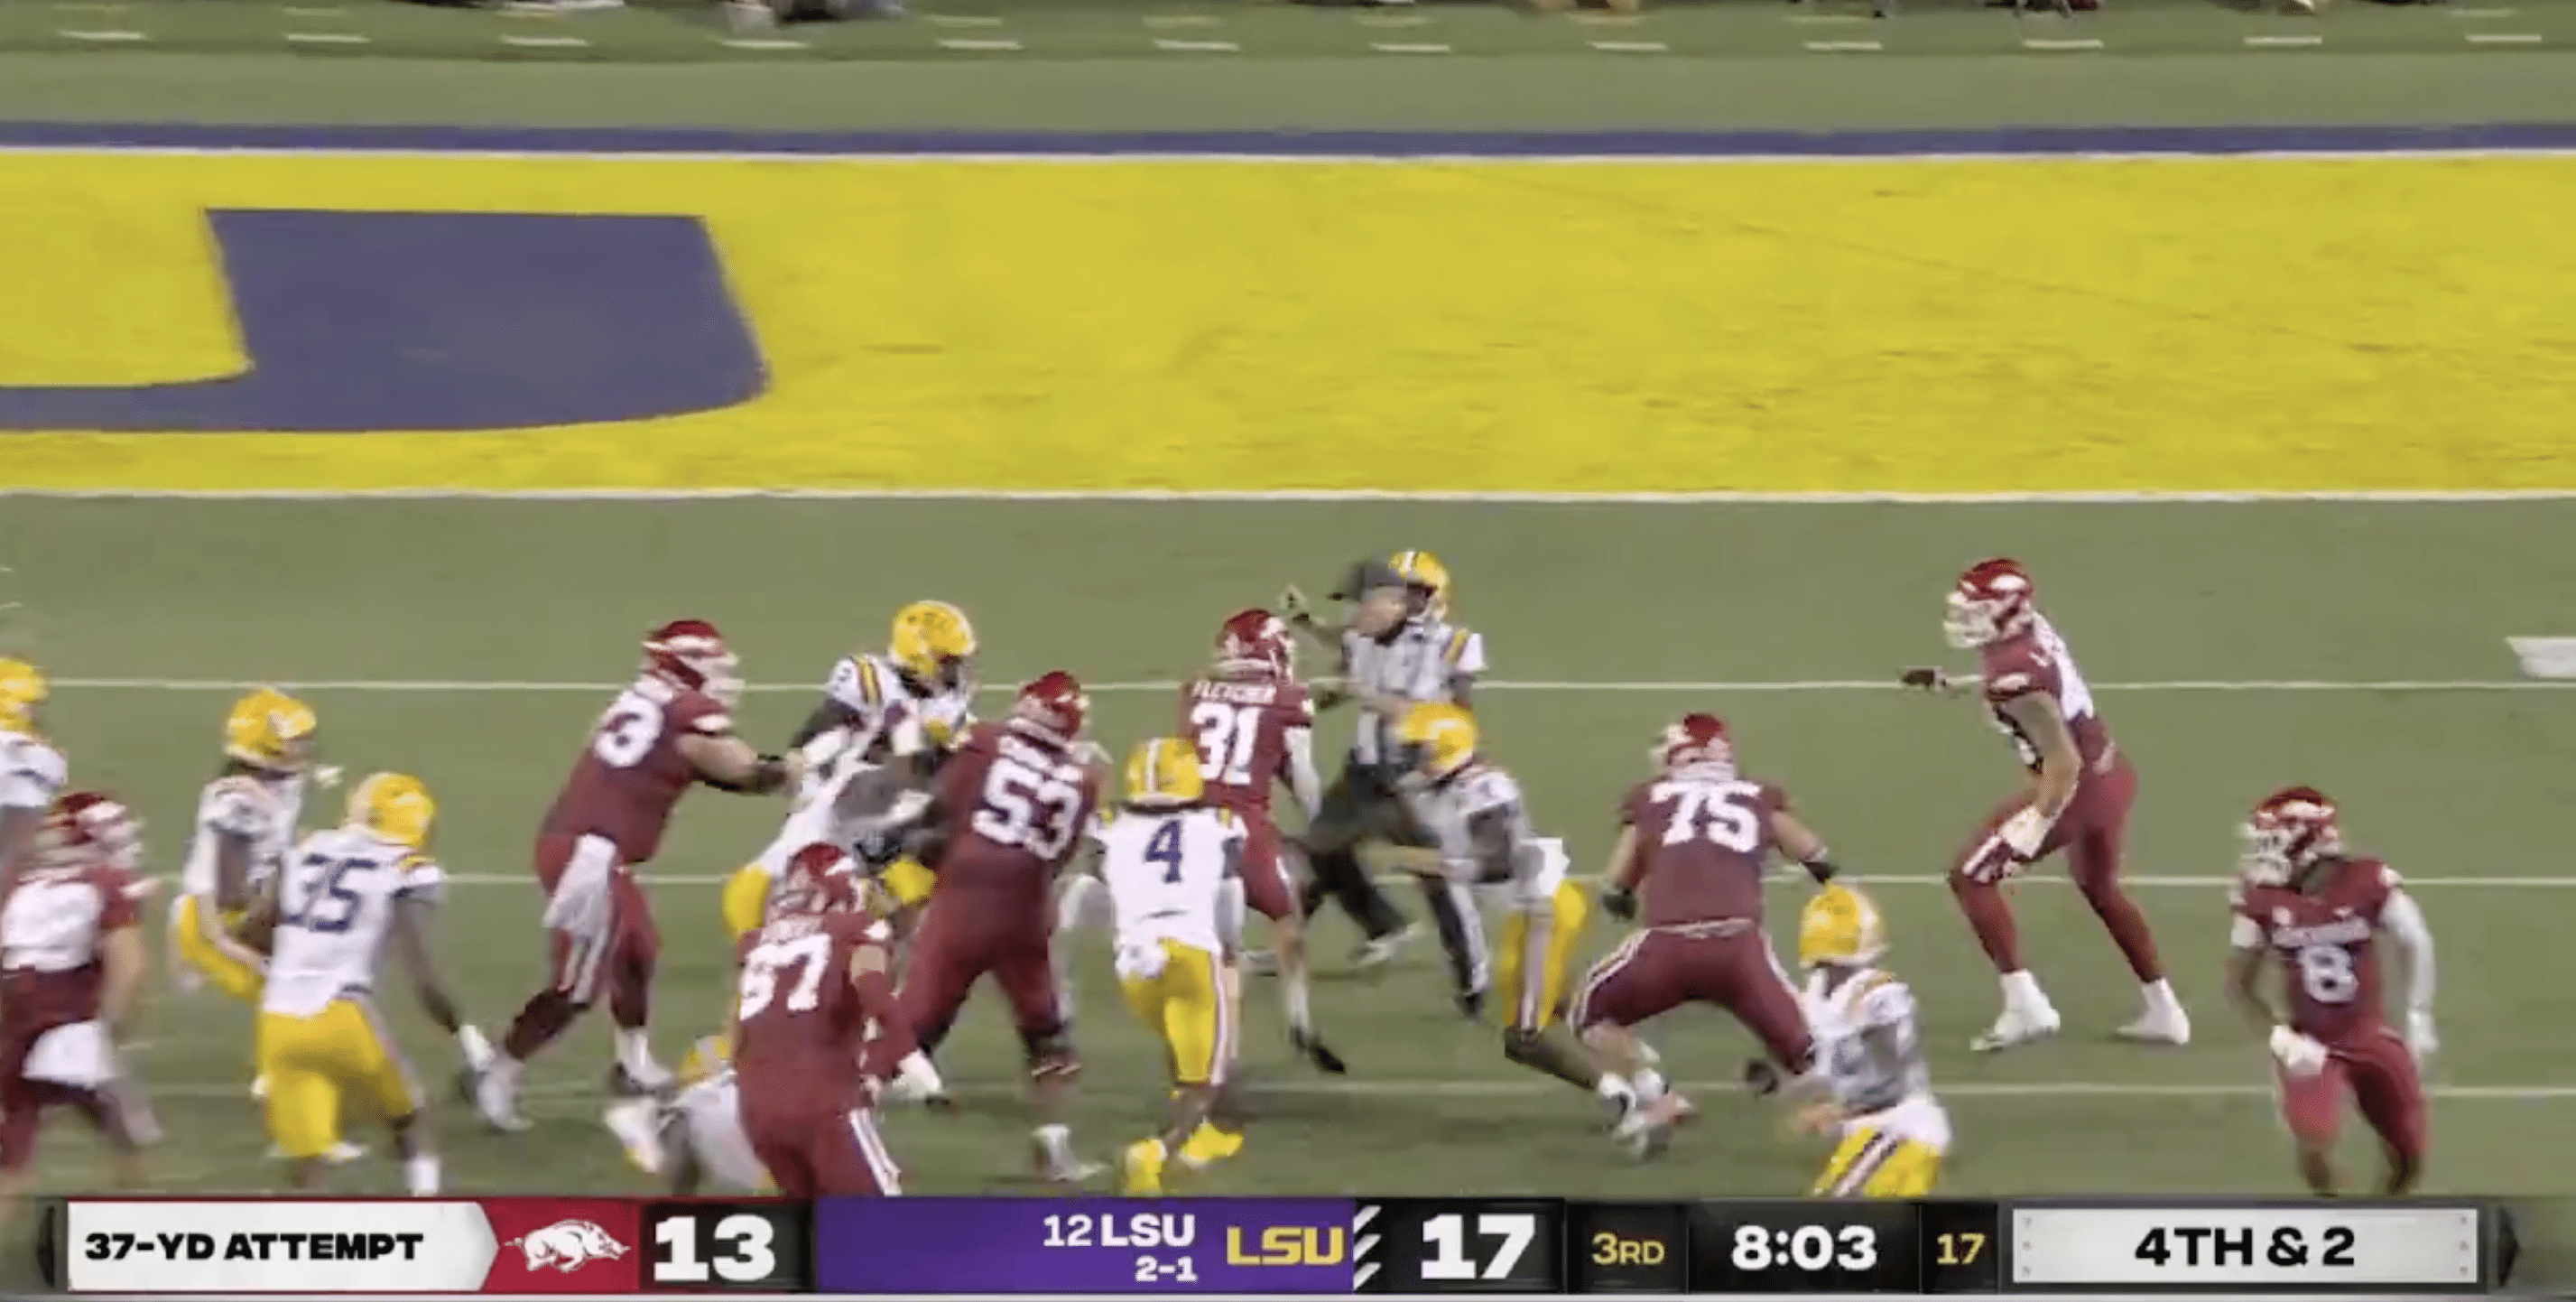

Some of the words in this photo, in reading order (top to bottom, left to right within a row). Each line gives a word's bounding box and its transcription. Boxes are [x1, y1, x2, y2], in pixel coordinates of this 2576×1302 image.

[1191, 702, 1264, 786] 31
[971, 757, 1083, 860] 53
[1649, 778, 1762, 853] 75
[1144, 822, 1185, 884] 4
[2297, 944, 2359, 1003] 8
